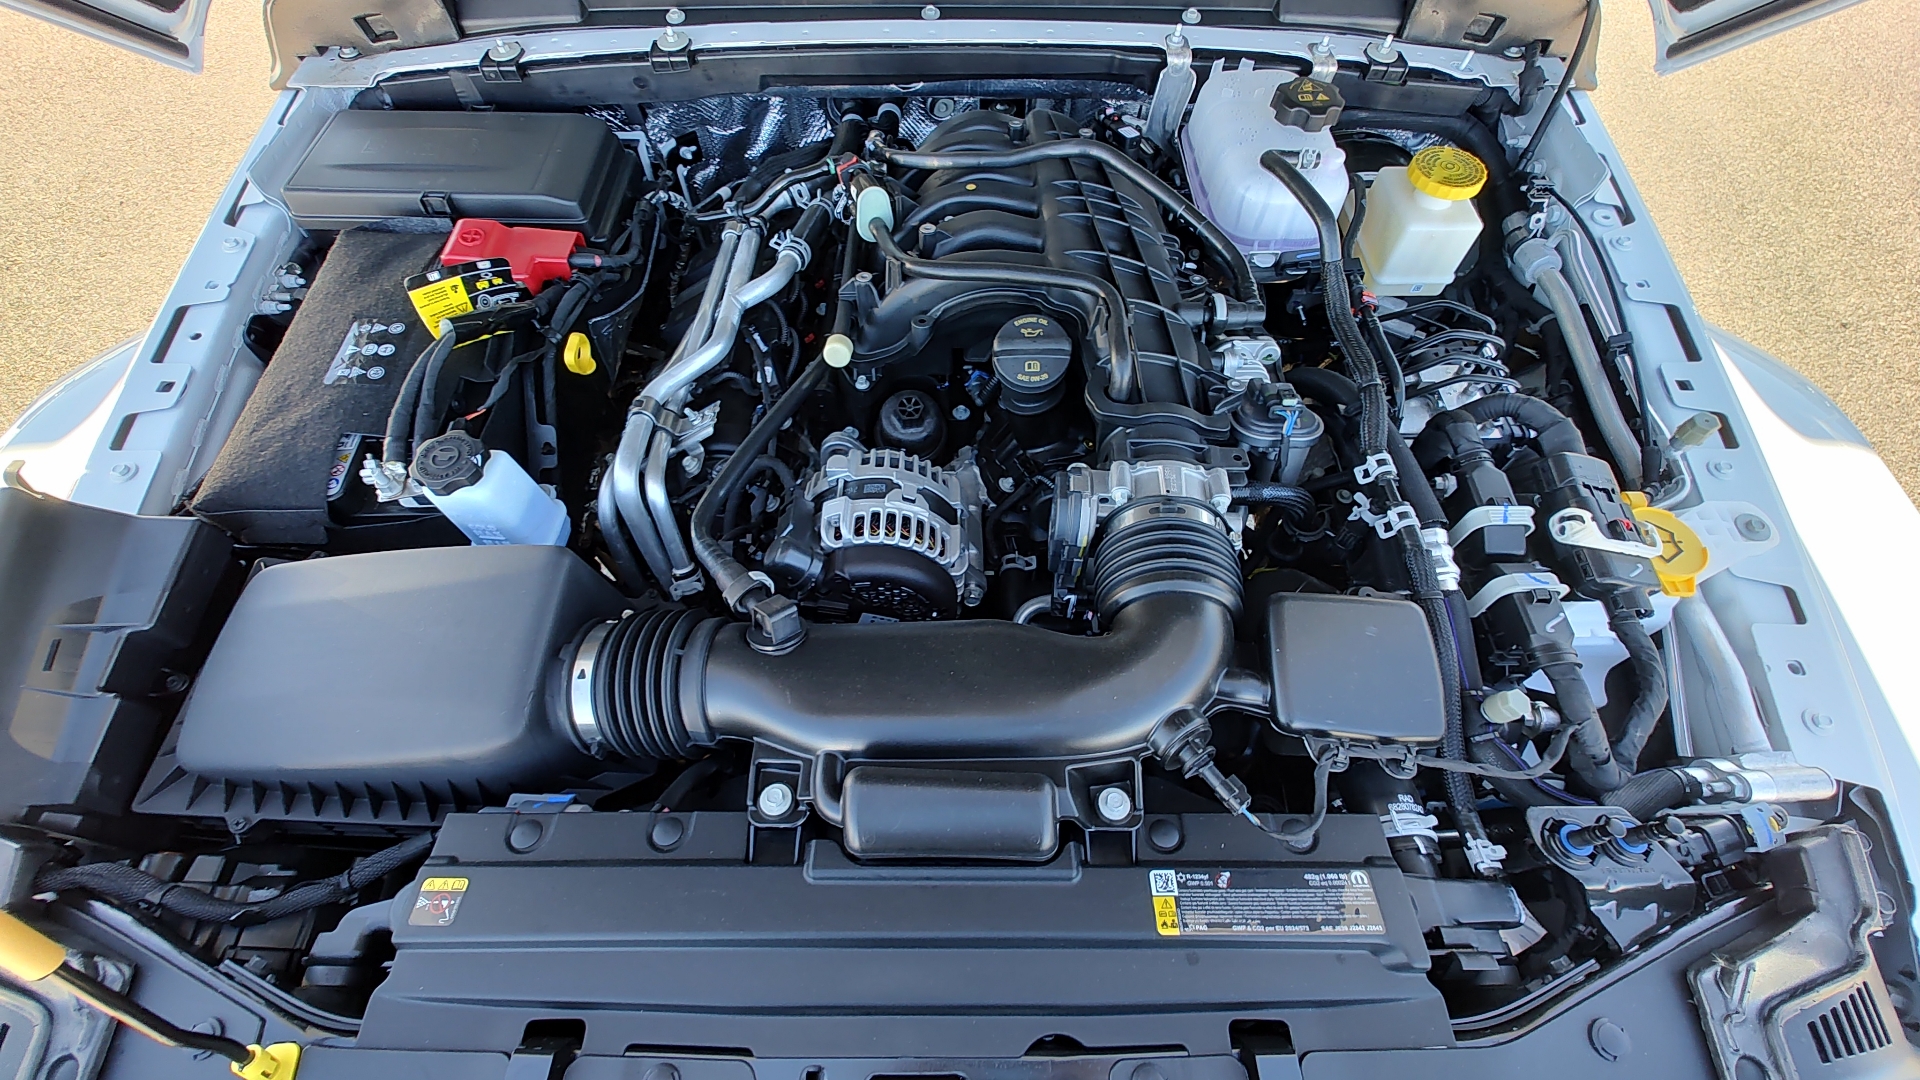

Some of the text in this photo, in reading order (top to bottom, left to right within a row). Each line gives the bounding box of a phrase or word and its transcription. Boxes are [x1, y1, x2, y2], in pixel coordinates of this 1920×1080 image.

[1014, 317, 1049, 326] ENGINE OIL
[1017, 373, 1030, 382] SAE
[1397, 793, 1414, 803] RAD
